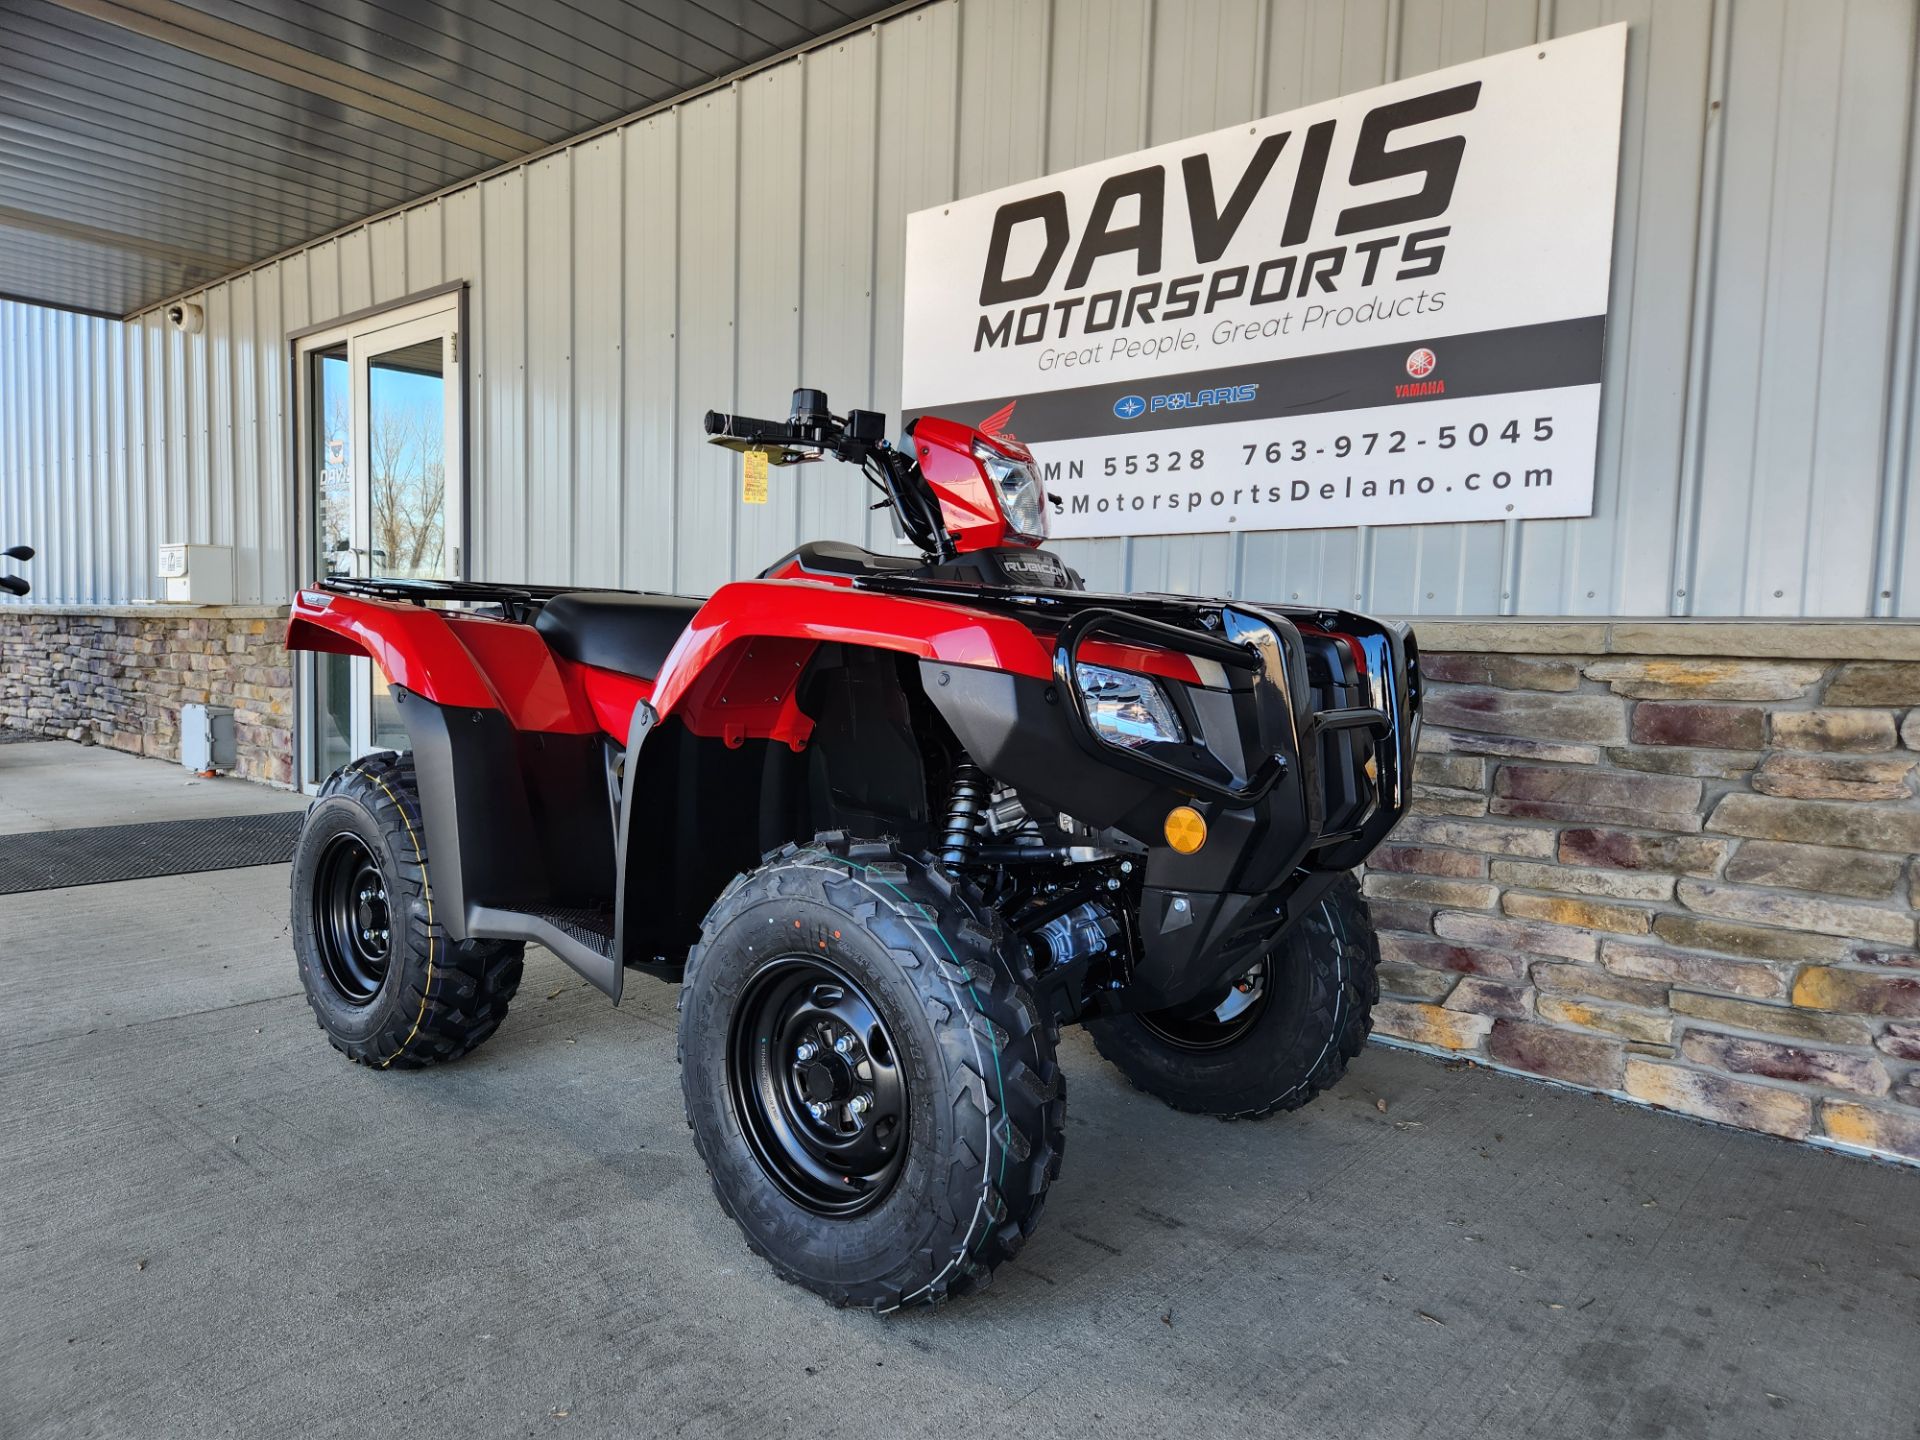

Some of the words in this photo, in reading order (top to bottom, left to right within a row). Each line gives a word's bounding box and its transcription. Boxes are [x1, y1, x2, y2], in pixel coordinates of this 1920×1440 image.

[979, 81, 1483, 306] DAVIS
[974, 226, 1452, 352] MOTORSPORTS
[1038, 341, 1103, 372] Great
[1110, 328, 1200, 361] People,
[1212, 314, 1291, 345] Great
[1302, 290, 1447, 331] Products
[1150, 383, 1257, 413] POLARIS
[1395, 379, 1445, 398] YAMAHA
[1044, 459, 1084, 481] MN
[1104, 449, 1205, 477] 55328
[1242, 416, 1554, 466] 763-972-5045
[1004, 561, 1064, 577] RUBICON
